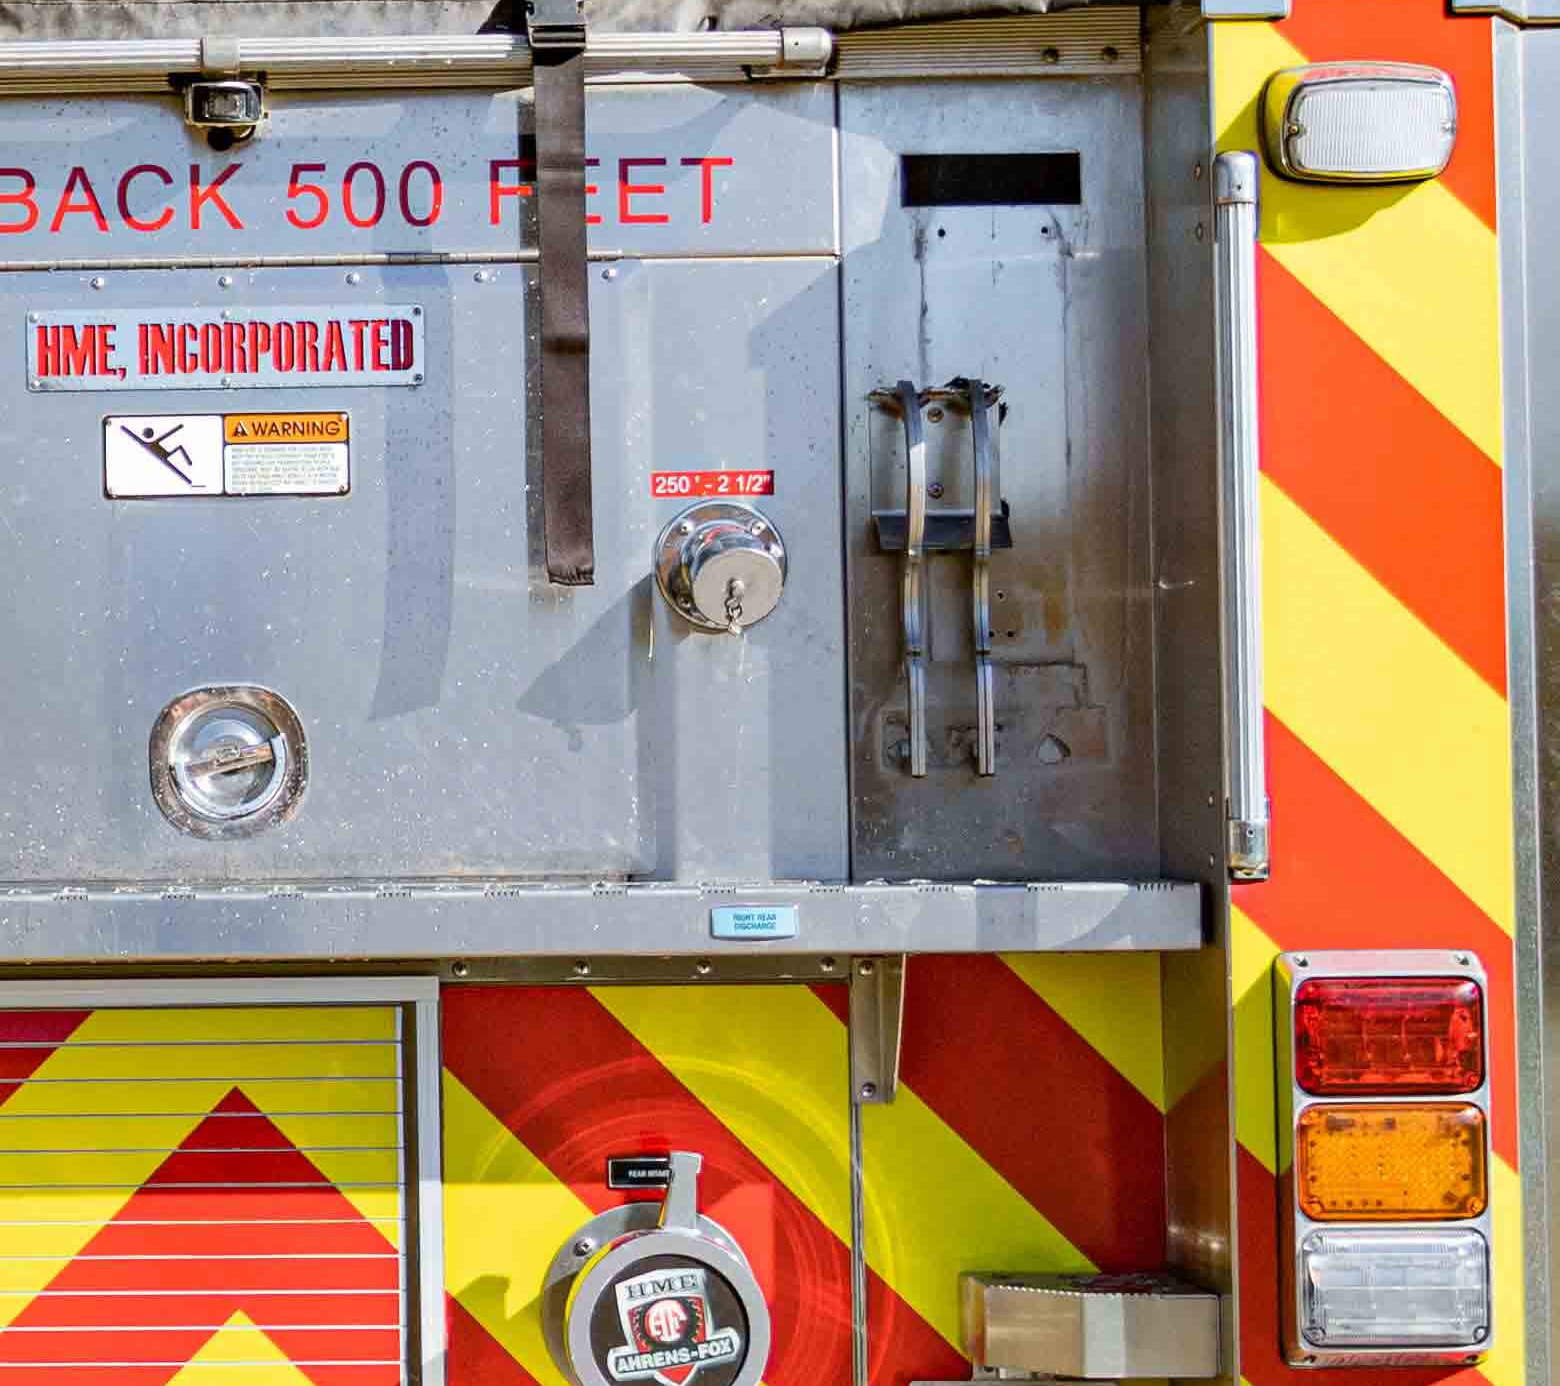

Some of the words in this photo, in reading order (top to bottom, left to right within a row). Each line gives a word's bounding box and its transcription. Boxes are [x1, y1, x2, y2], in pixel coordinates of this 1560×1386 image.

[285, 160, 443, 229] 500
[36, 324, 126, 380] HME,
[137, 319, 415, 375] INCORPORATED
[251, 421, 341, 437] WARNING
[656, 476, 688, 493] 250
[718, 475, 729, 492] 2
[616, 1336, 732, 1373] AHRENS-FOX
